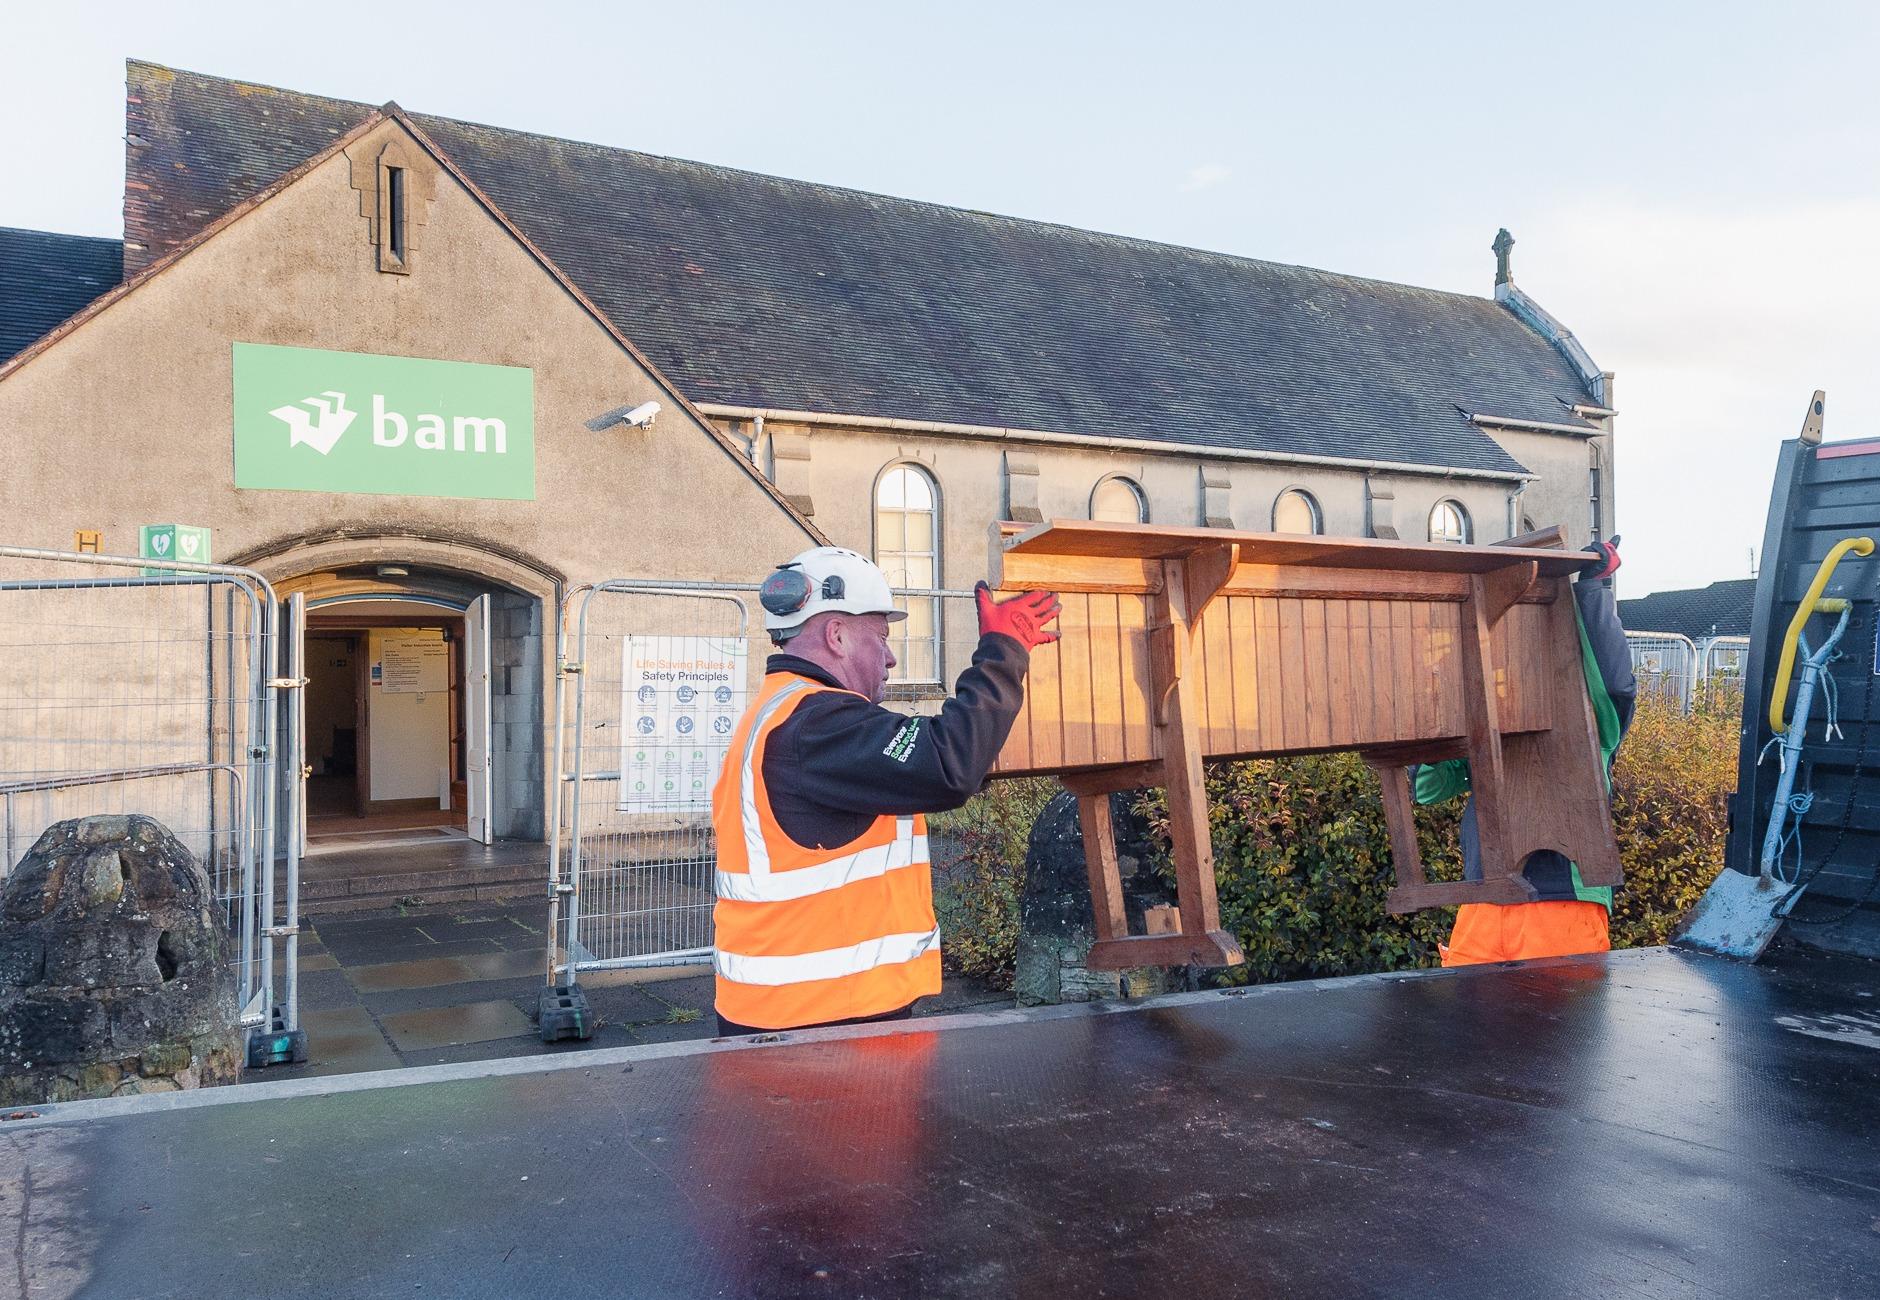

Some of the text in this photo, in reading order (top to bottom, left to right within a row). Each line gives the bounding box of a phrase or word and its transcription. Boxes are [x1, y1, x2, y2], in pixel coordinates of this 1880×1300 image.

[373, 394, 507, 454] bam
[79, 533, 98, 553] H
[636, 659, 736, 671] Life Saving Rules &
[642, 671, 729, 683] Safety Principles
[897, 743, 915, 763] Every
